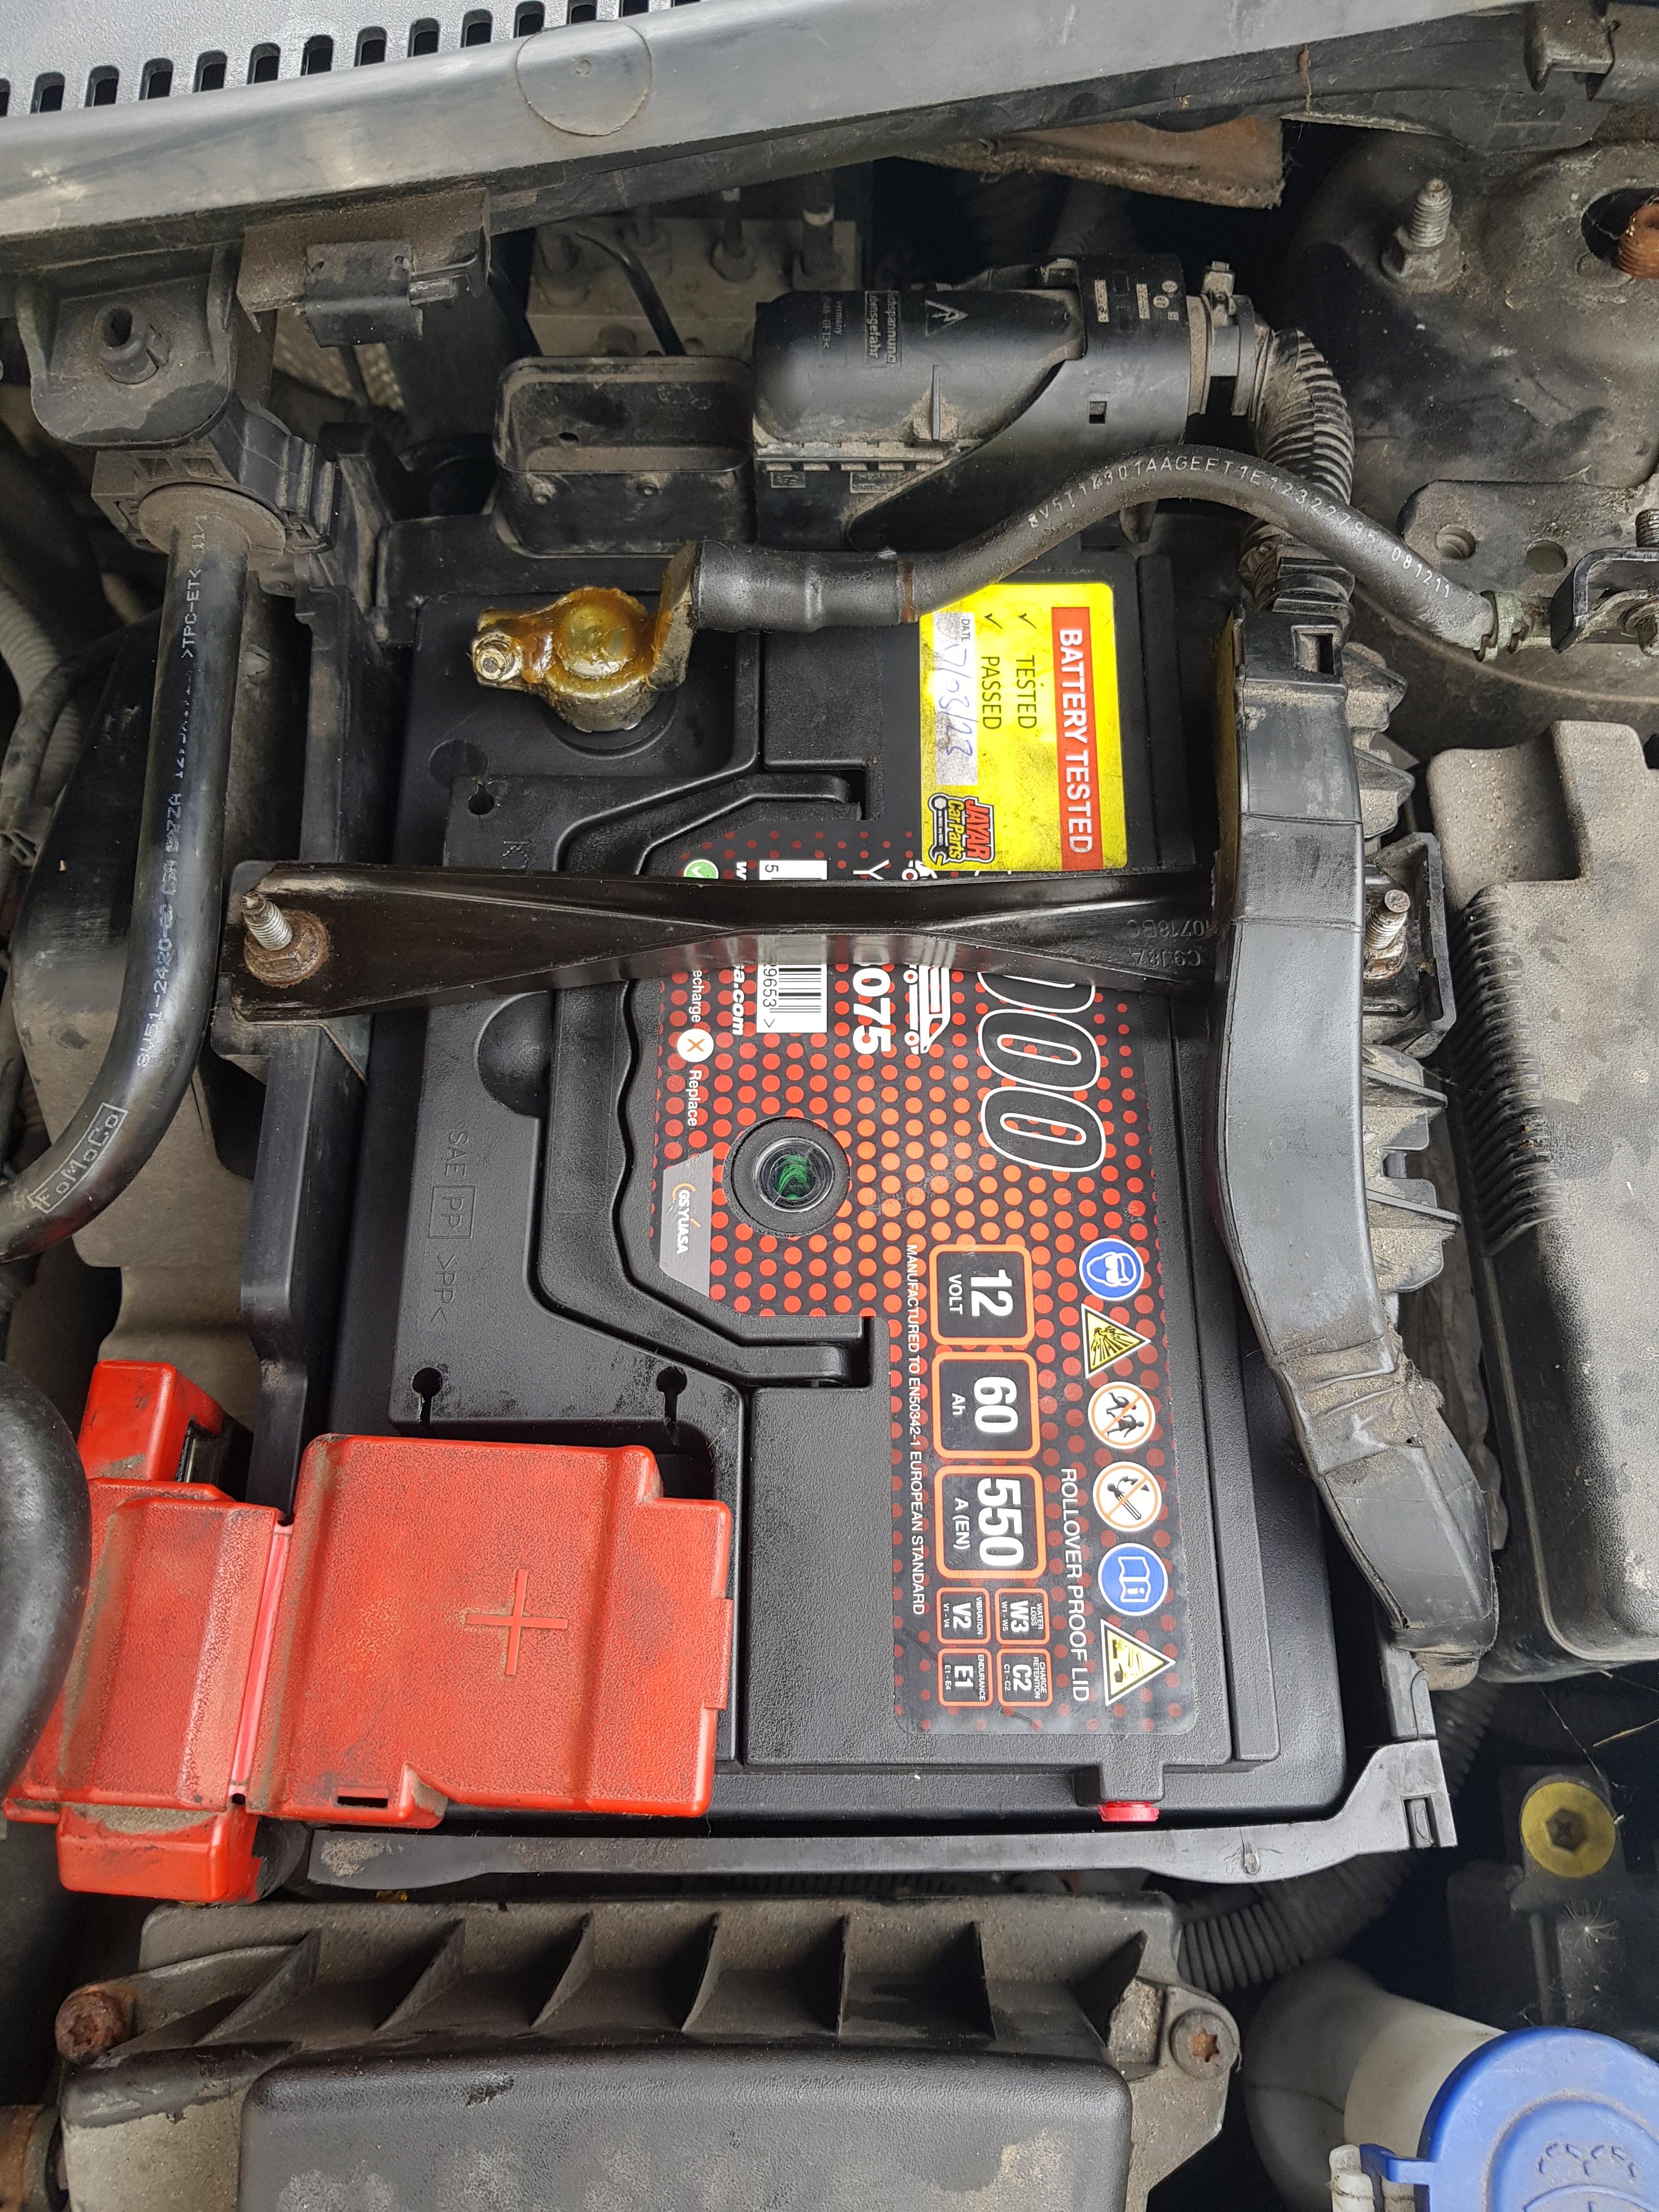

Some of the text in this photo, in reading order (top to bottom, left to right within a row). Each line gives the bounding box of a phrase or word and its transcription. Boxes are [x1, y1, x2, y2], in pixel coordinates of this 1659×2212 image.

[961, 619, 970, 641] DATE
[981, 656, 1002, 730] PASSED
[1015, 655, 1037, 729] TESTED
[1059, 629, 1093, 853] BATTERY TESTED
[948, 800, 965, 859] Car Parts
[966, 800, 990, 859] JAYAR
[689, 970, 703, 1023] echarge
[686, 1070, 702, 1127] Replace
[35, 1111, 120, 1208] FoMoCo
[429, 1130, 470, 1327] SAE PP >PP<
[676, 1188, 695, 1254] GS YUASA
[948, 1274, 963, 1314] VOLT
[969, 1269, 1013, 1317] 12
[906, 1244, 925, 1615] MANUFACTURED TO EN50342-1 EUROPEAN STANDARD
[951, 1393, 966, 1415] Ah
[973, 1376, 1018, 1434] 60
[952, 1497, 970, 1550] A (EN)
[977, 1478, 1024, 1566] 550
[1061, 1468, 1090, 1702] ROLLOVER PROOF LID
[952, 1602, 971, 1629] V2
[975, 1596, 984, 1635] VIBRATION
[1010, 1600, 1028, 1633] W3
[954, 1665, 974, 1689] E1
[977, 1654, 985, 1701] ENDURANCE
[1012, 1664, 1031, 1691] C2
